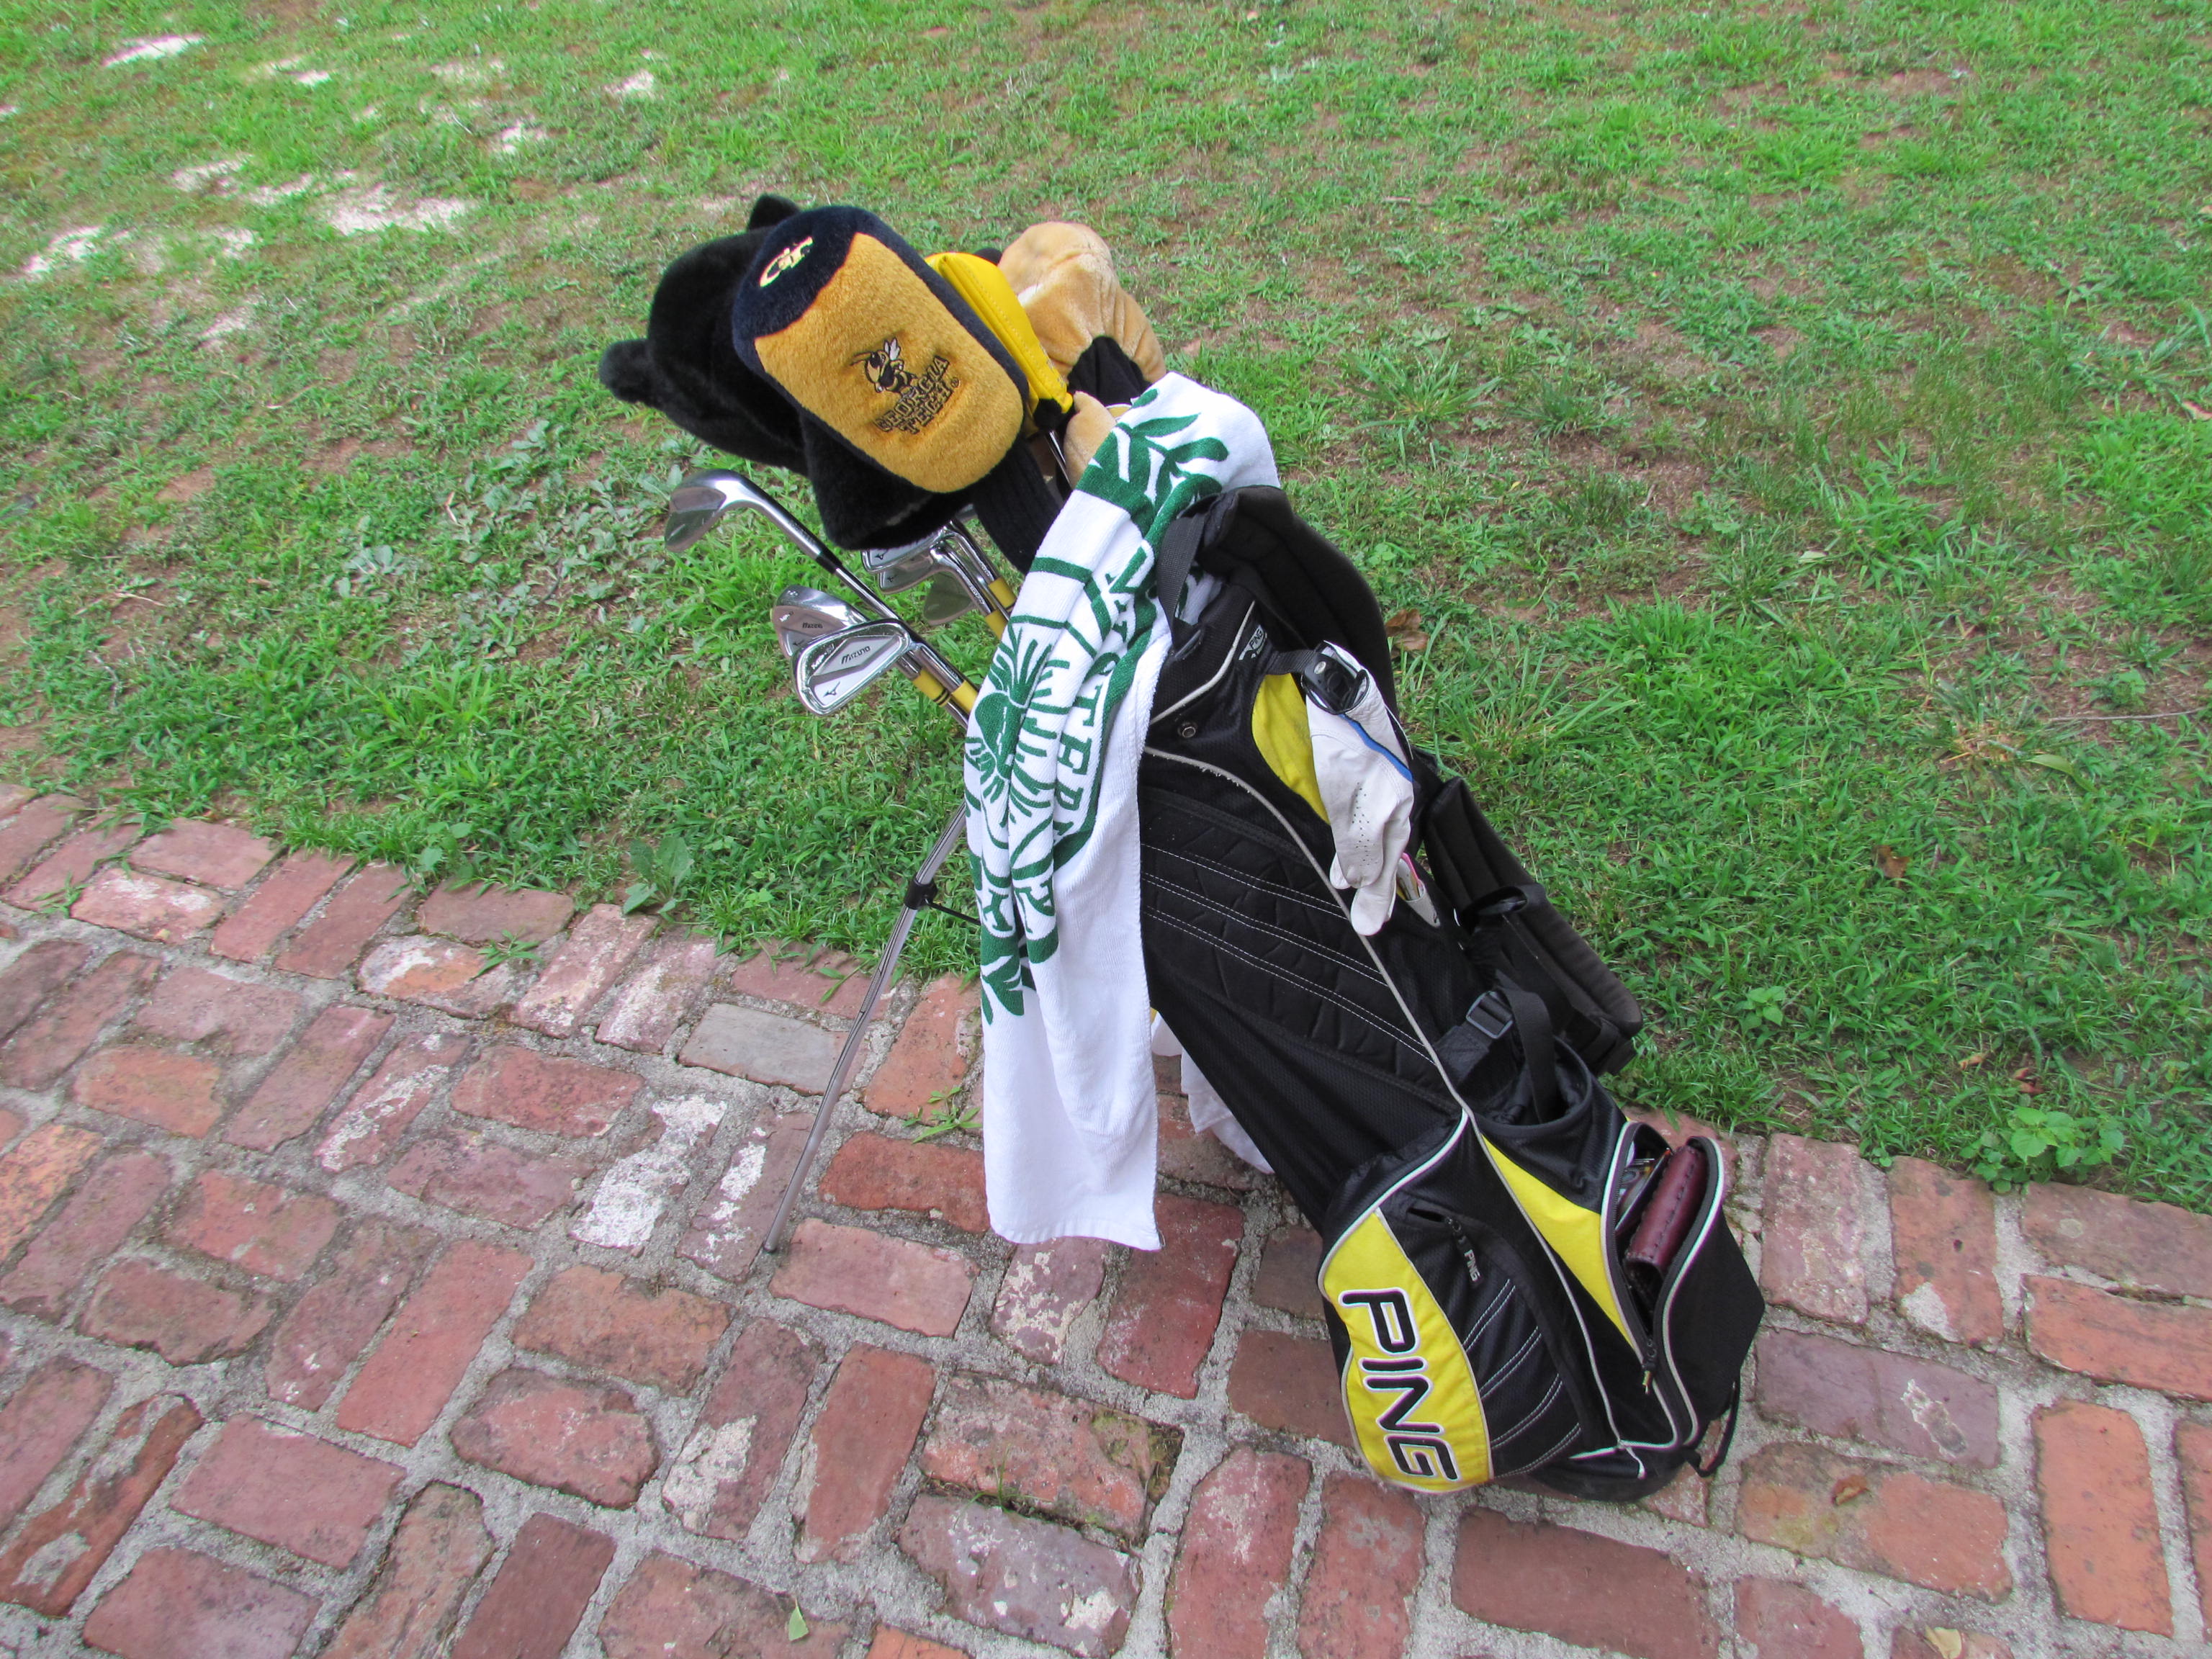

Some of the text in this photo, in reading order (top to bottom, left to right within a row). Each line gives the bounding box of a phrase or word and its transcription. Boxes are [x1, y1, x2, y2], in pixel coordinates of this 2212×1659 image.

[872, 356, 949, 432] GEORGIA
[899, 379, 953, 434] TECH
[1249, 628, 1264, 650] PING
[1464, 1249, 1481, 1282] PING
[1339, 1287, 1462, 1482] PING
